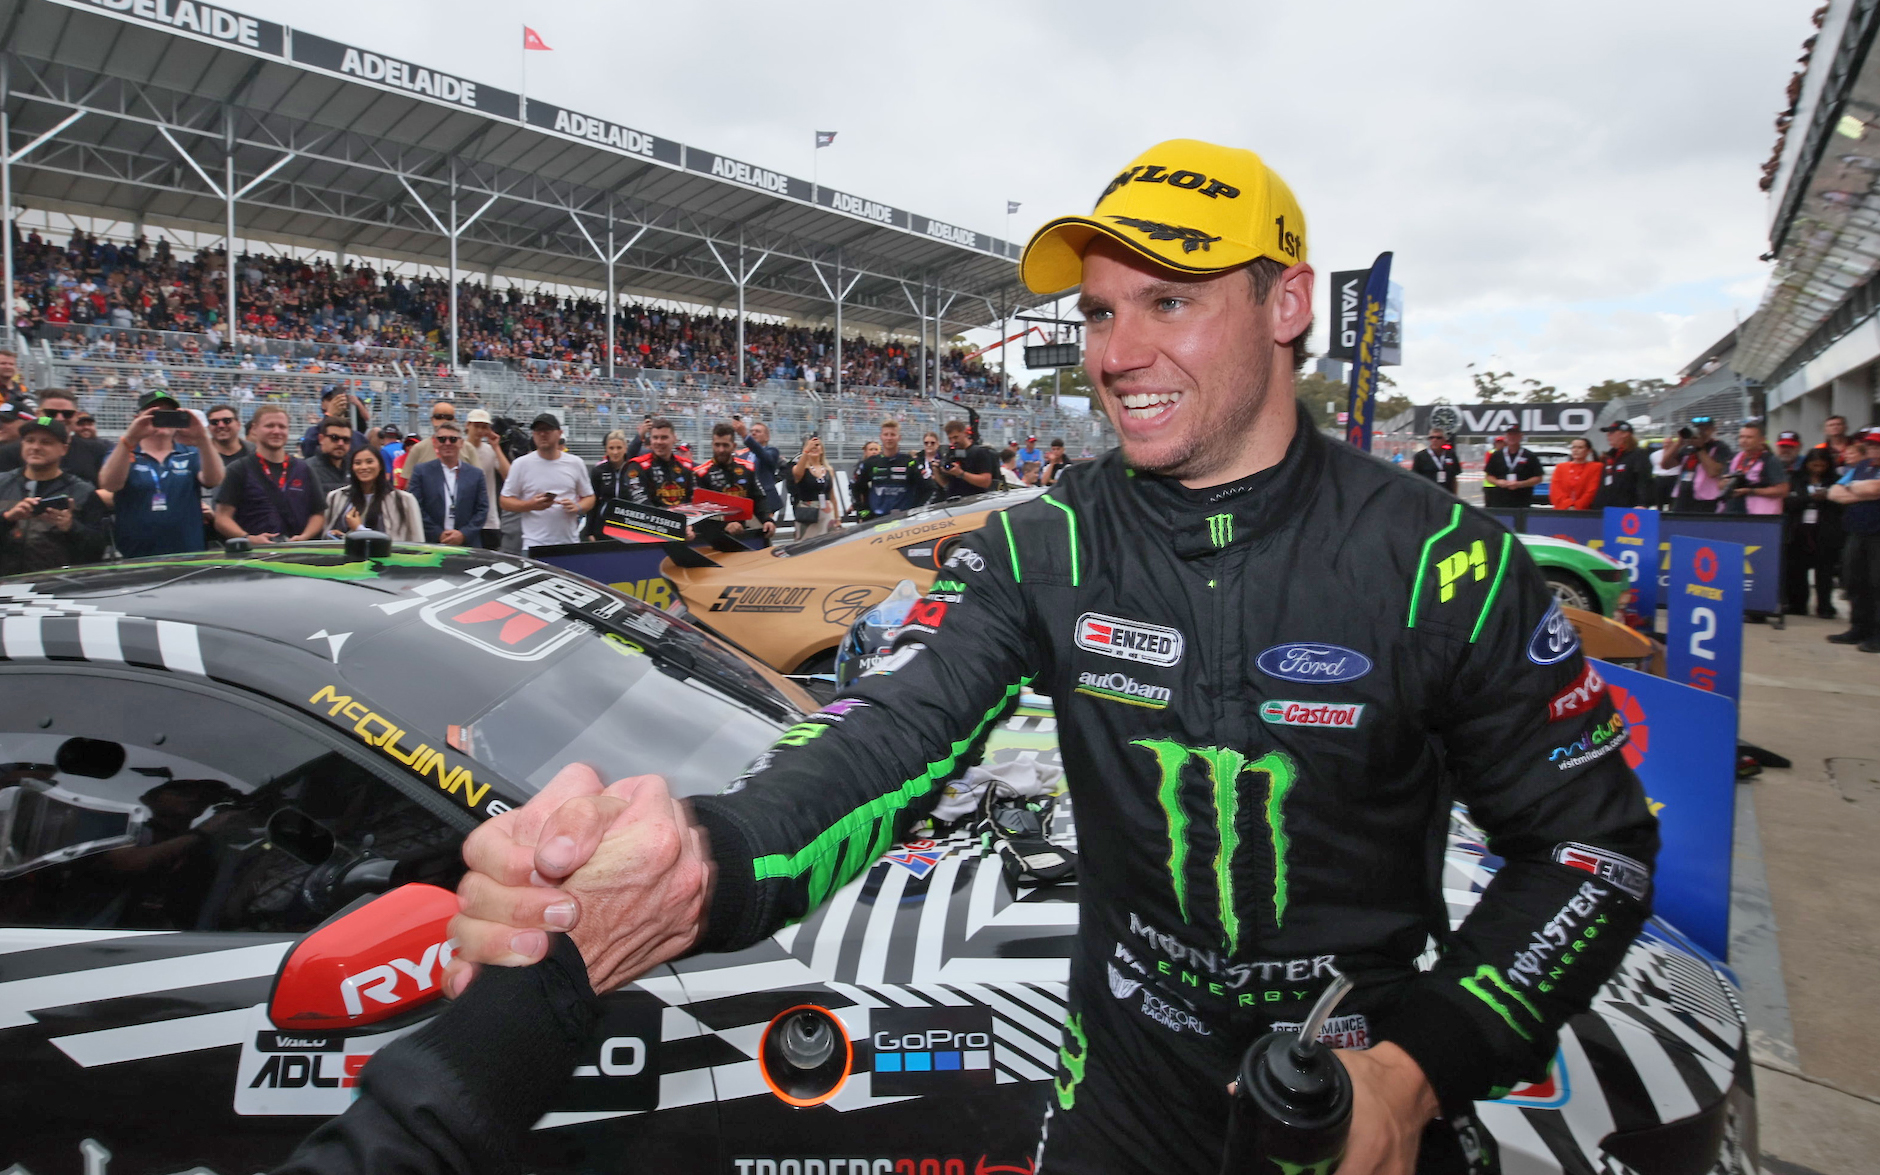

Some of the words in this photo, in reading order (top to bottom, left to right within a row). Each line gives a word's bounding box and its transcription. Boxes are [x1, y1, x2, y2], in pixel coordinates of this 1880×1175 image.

[91, 0, 259, 47] ELAIDE
[341, 49, 477, 107] ADELAIDE
[554, 110, 654, 156] ADELAIDE
[712, 157, 788, 194] ADELAIDE
[1094, 164, 1241, 210] NLOP
[832, 192, 892, 224] ADELAIDE
[927, 220, 976, 247] ADELAIDE
[1275, 214, 1301, 259] 1st
[1341, 278, 1358, 348] VAILO
[1463, 408, 1594, 432] VAILO
[614, 507, 647, 520] DASHER
[650, 515, 682, 530] FISHER
[886, 519, 956, 541] AUTODESK
[495, 577, 602, 623] ENZED
[1111, 627, 1173, 656] ENZED
[1689, 607, 1716, 661] 2
[1279, 648, 1347, 677] Ford
[1284, 703, 1354, 727] Castrol
[1538, 913, 1610, 994] ENERGY
[1158, 960, 1309, 1008] ENERGY
[1141, 1003, 1180, 1033] RACING
[874, 1030, 990, 1051] GoPro
